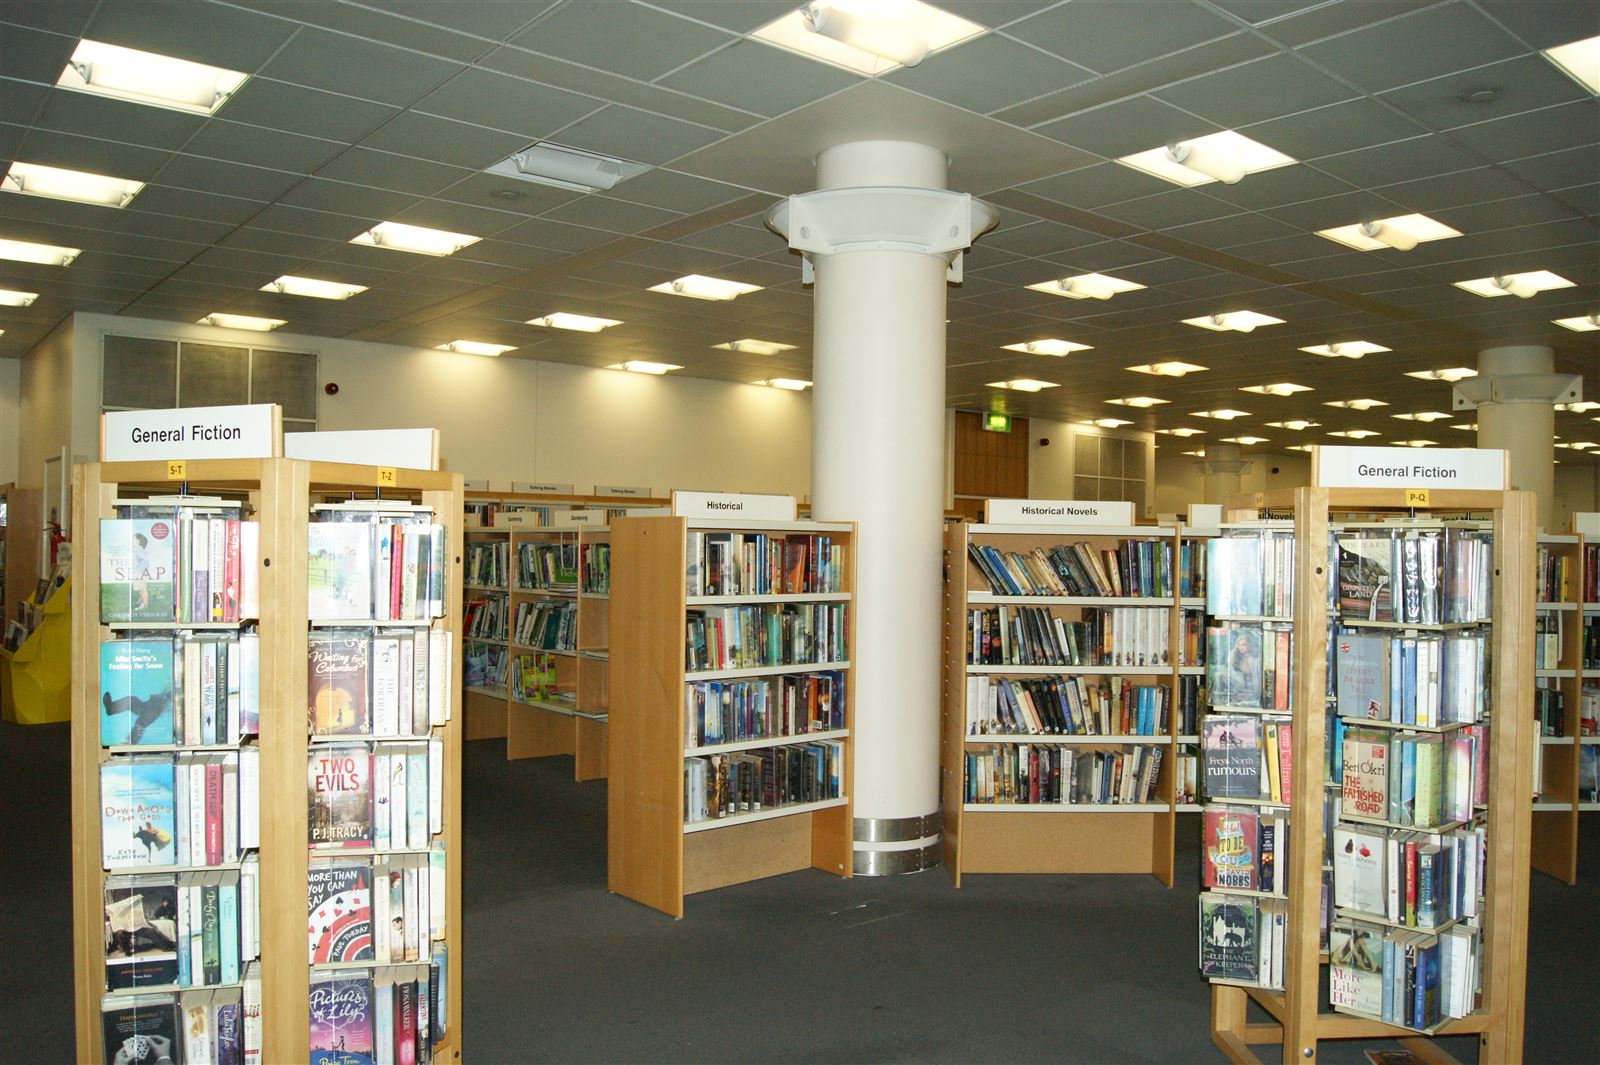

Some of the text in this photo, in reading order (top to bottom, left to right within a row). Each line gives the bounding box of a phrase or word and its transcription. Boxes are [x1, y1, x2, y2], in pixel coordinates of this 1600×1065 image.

[131, 424, 241, 443] General Fiction
[170, 465, 182, 475] S-T
[381, 471, 393, 481] T-Z
[1358, 464, 1457, 478] General Fiction
[1410, 493, 1426, 502] P-Q
[706, 501, 743, 510] Historical
[1021, 506, 1098, 515] Historical Novels
[115, 567, 166, 581] SLAP
[309, 651, 349, 665] Waiting
[320, 758, 355, 774] TWO
[1231, 757, 1254, 765] North
[1343, 760, 1385, 776] Ben Okri
[1208, 766, 1257, 776] rumours
[315, 773, 360, 793] EVILS
[1344, 775, 1360, 789] THE
[1343, 788, 1384, 803] FAMISHED
[1355, 801, 1380, 814] ROAD
[330, 826, 363, 839] TRACY
[1220, 836, 1243, 852] TO BE
[1212, 853, 1238, 866] YOU
[308, 870, 358, 882] MORE THAN
[1218, 874, 1250, 887] NOBBS
[308, 881, 345, 897] YOU CAN
[204, 890, 217, 914] Derby
[308, 894, 324, 911] SAY
[205, 913, 216, 933] Day
[332, 940, 345, 957] PAUL
[1332, 967, 1364, 983] More
[1332, 979, 1361, 995] Like
[309, 989, 362, 1009] Pictures
[1332, 991, 1356, 1008] Her
[223, 1010, 231, 1029] Lulu
[313, 1003, 358, 1024] of Lily
